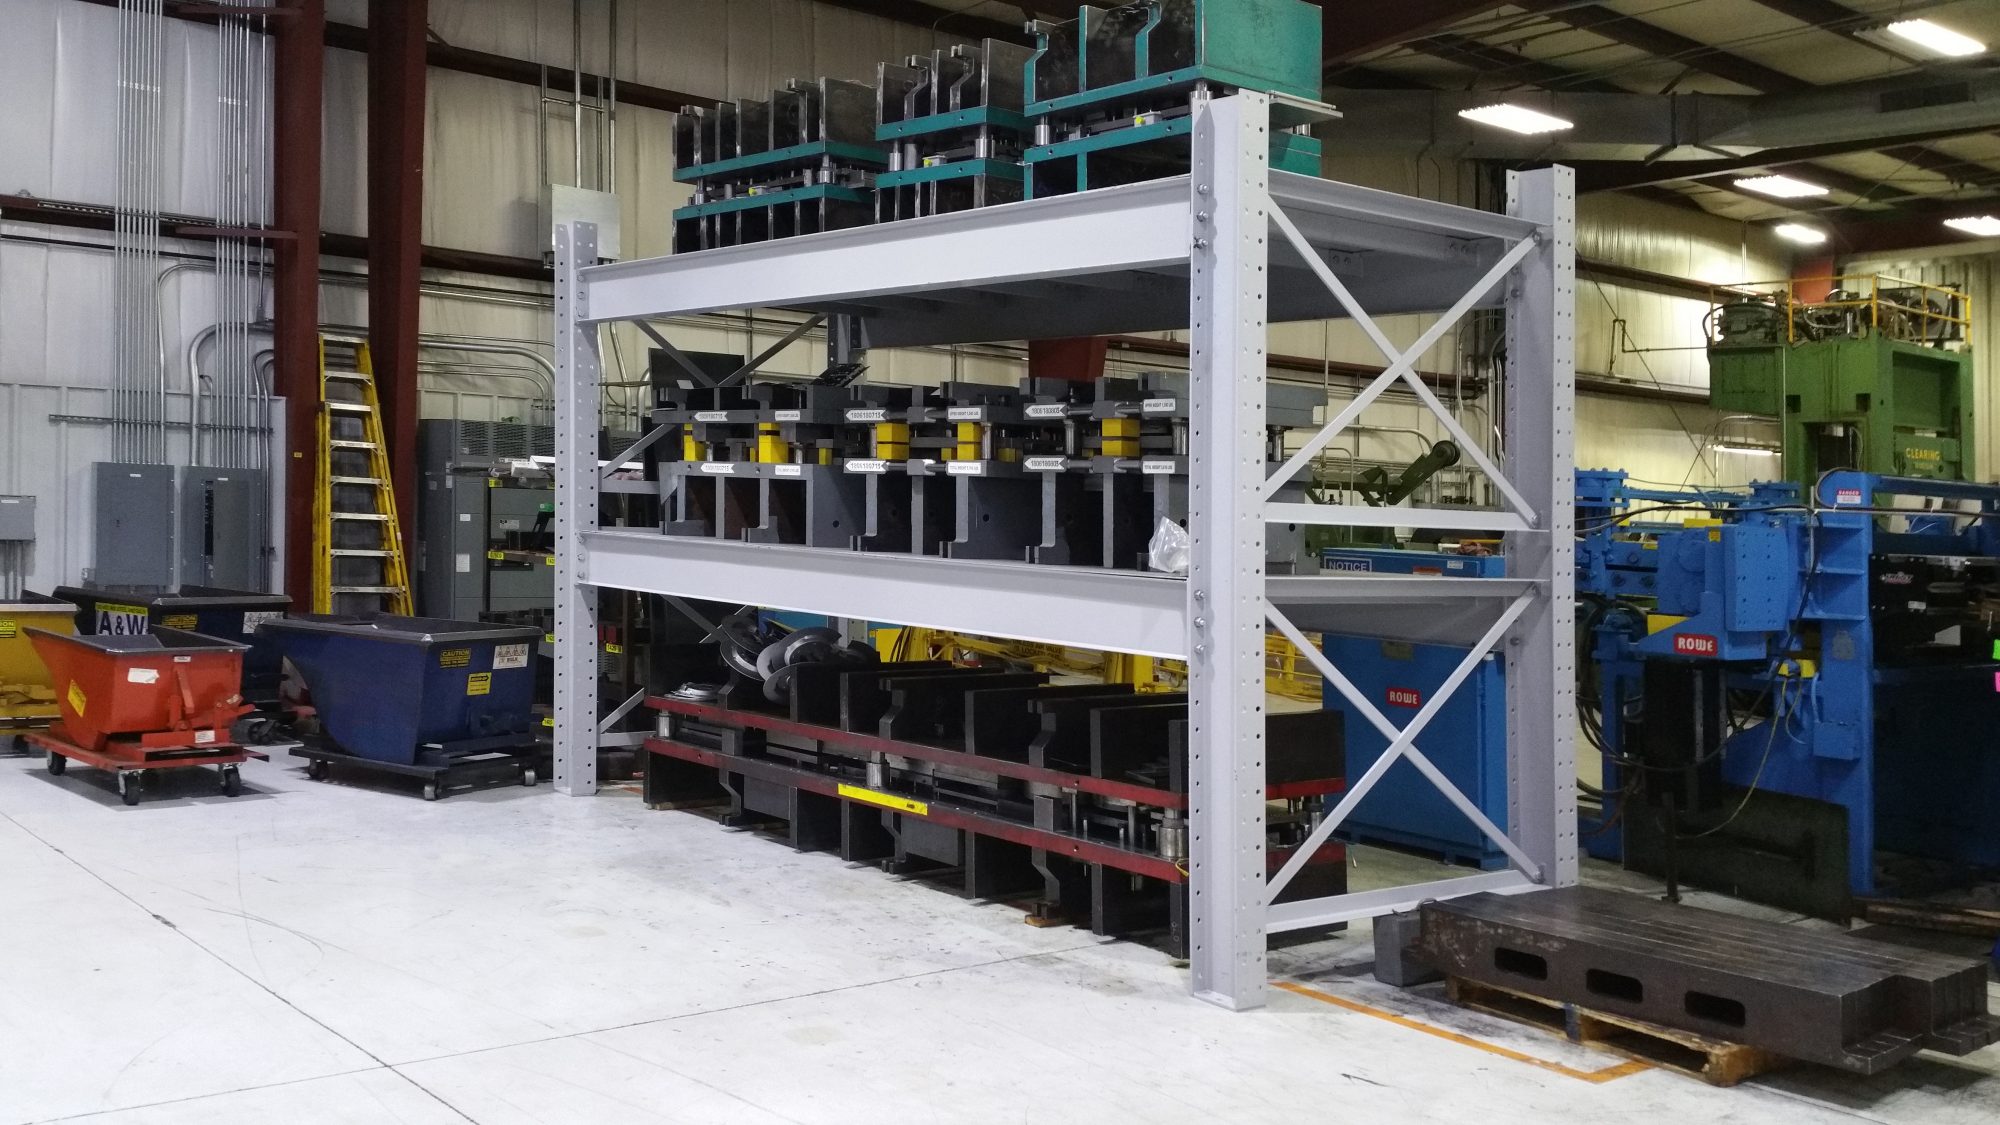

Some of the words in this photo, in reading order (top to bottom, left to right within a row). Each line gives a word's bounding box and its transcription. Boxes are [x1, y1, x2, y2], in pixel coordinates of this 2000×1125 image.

[1906, 447, 1941, 461] CLEARING
[1328, 561, 1368, 572] NOTICE
[99, 611, 113, 635] A
[115, 615, 124, 635] &
[1678, 637, 1714, 652] ROWE
[1389, 691, 1418, 704] ROWE
